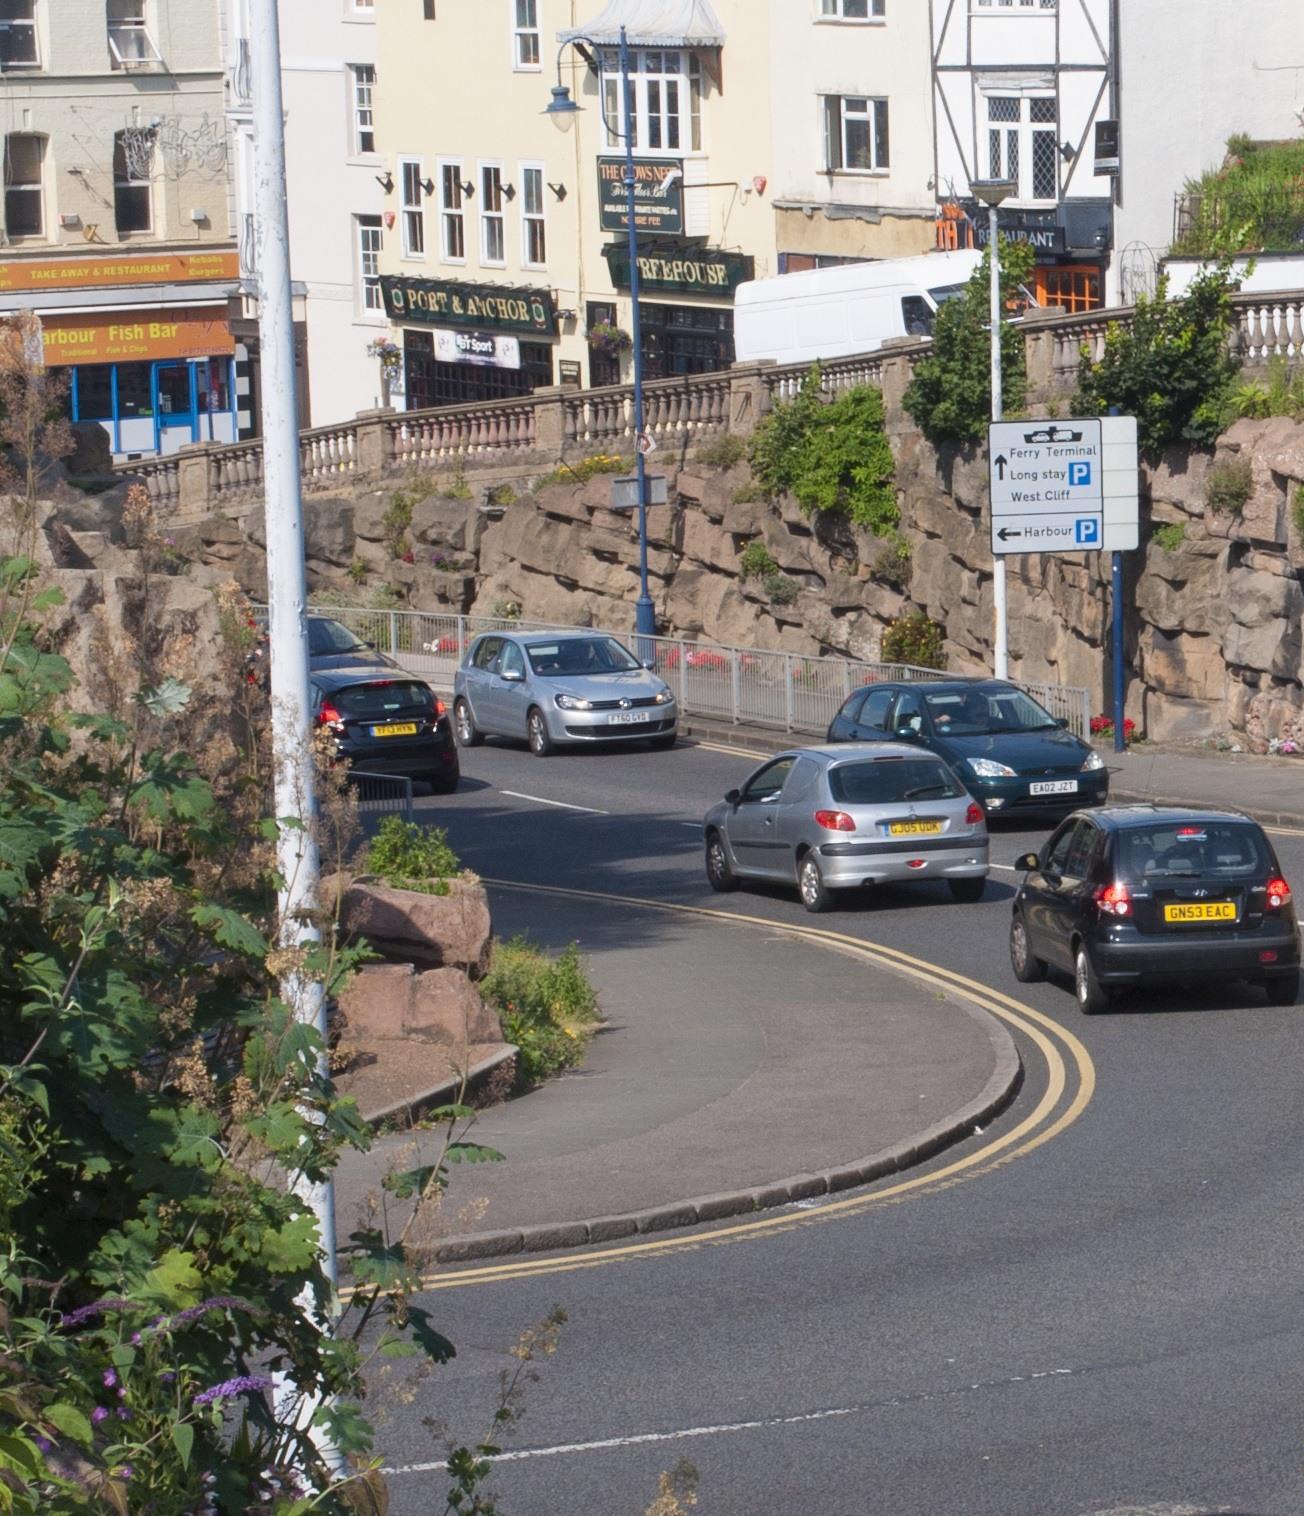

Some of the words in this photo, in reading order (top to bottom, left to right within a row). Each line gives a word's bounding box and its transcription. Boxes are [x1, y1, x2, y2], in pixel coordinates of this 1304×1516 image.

[600, 164, 619, 180] THE
[620, 165, 653, 181] COWS
[978, 230, 1055, 248] REAURANT
[189, 255, 224, 265] Kebabs
[30, 269, 59, 280] TAKE
[60, 267, 90, 278] AWAY
[103, 263, 172, 277] RESTAURANT
[636, 256, 729, 285] REEHOUSE
[407, 289, 448, 313] PORT
[452, 294, 464, 314] &
[467, 294, 530, 321] ANCHOR
[42, 328, 96, 345] arbour
[109, 324, 144, 341] Fish
[150, 321, 178, 338] Bar
[1010, 448, 1040, 459] Ferry
[1046, 445, 1096, 457] Terminal
[1010, 470, 1038, 482] Long
[1042, 469, 1066, 481] stay
[1073, 464, 1088, 485] P
[1011, 491, 1041, 502] West
[1045, 489, 1070, 501] Cliff
[1024, 526, 1072, 537] Harbour
[1080, 521, 1095, 542] P
[1033, 783, 1056, 793] EA02
[1057, 781, 1073, 791] JZT
[1170, 906, 1202, 919] GN53
[1206, 906, 1230, 918] EAC
